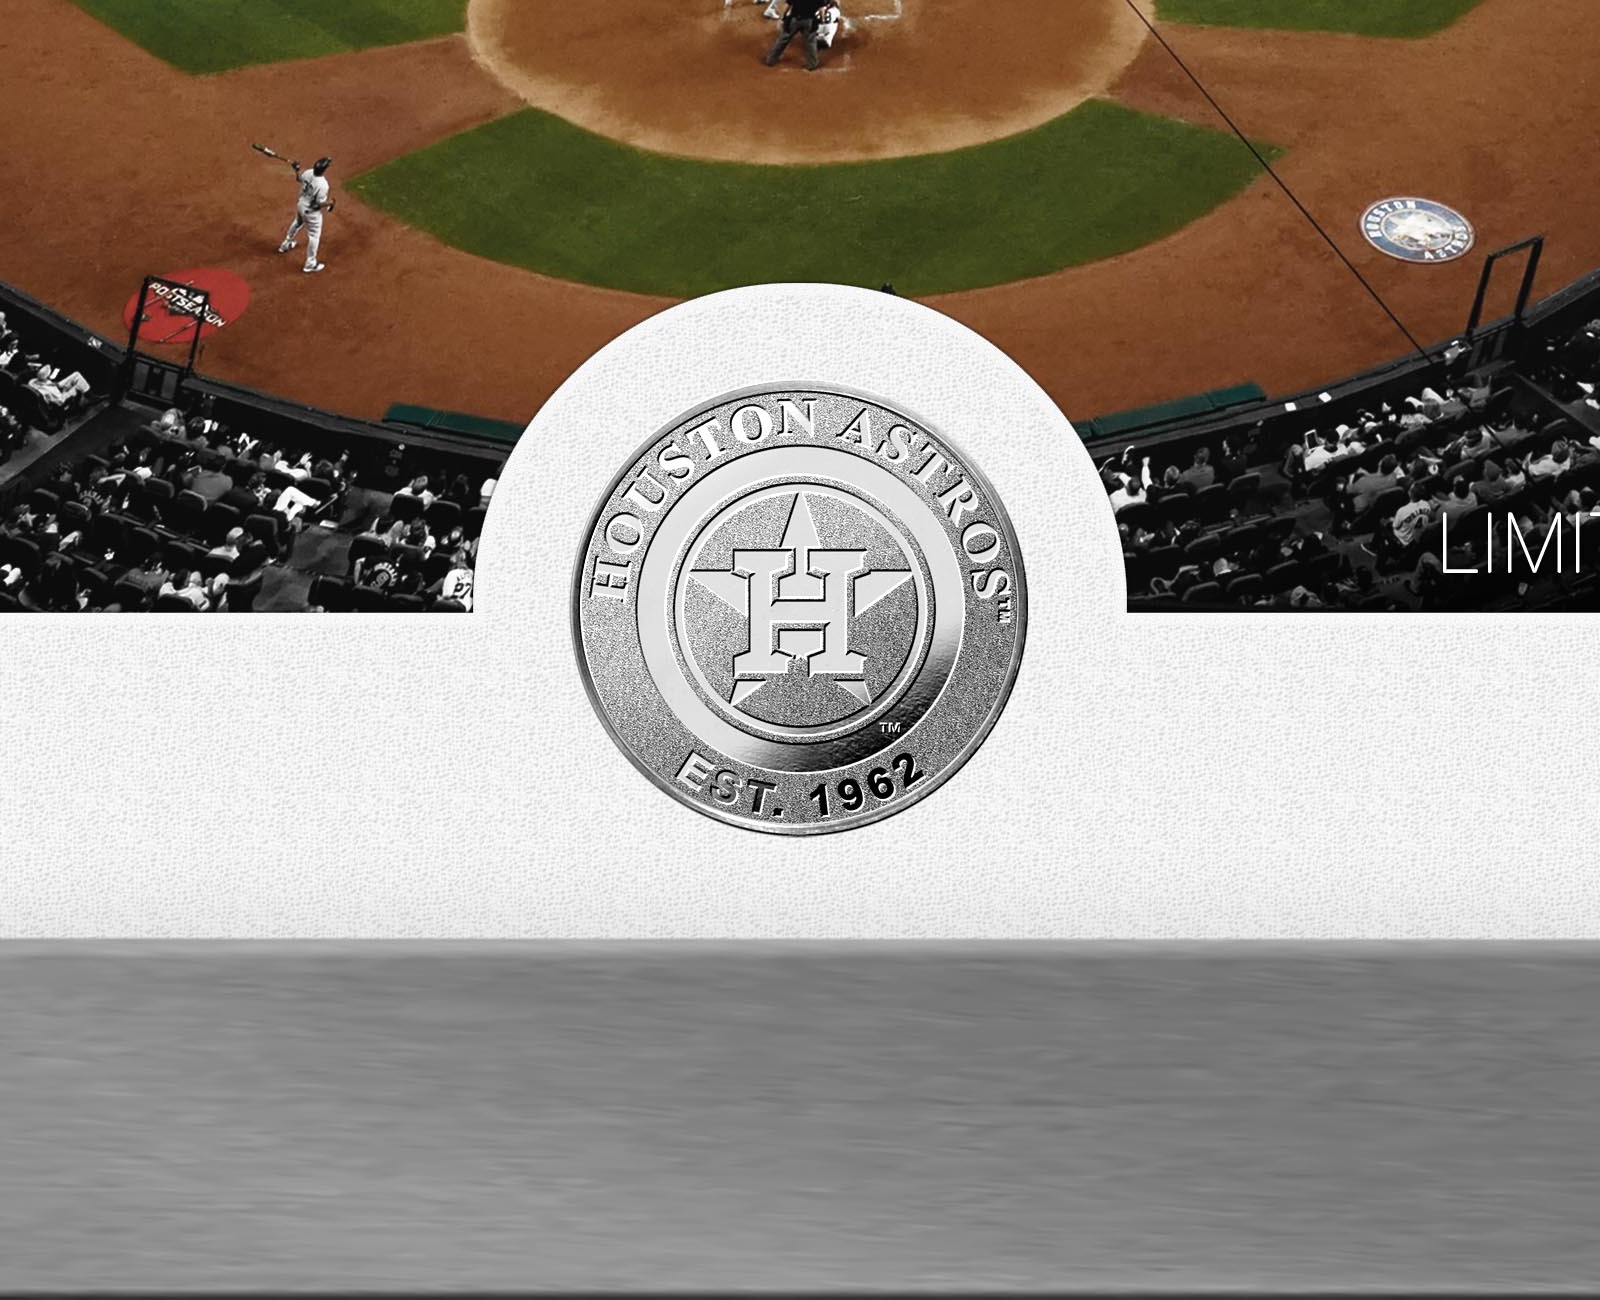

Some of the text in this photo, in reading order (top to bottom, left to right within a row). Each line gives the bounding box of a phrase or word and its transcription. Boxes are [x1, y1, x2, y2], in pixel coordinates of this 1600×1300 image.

[1366, 200, 1416, 238] HOUSTON
[589, 399, 1012, 603] HOUSTON ASTROS
[732, 548, 868, 678] H
[675, 749, 925, 818] EST. 1962
